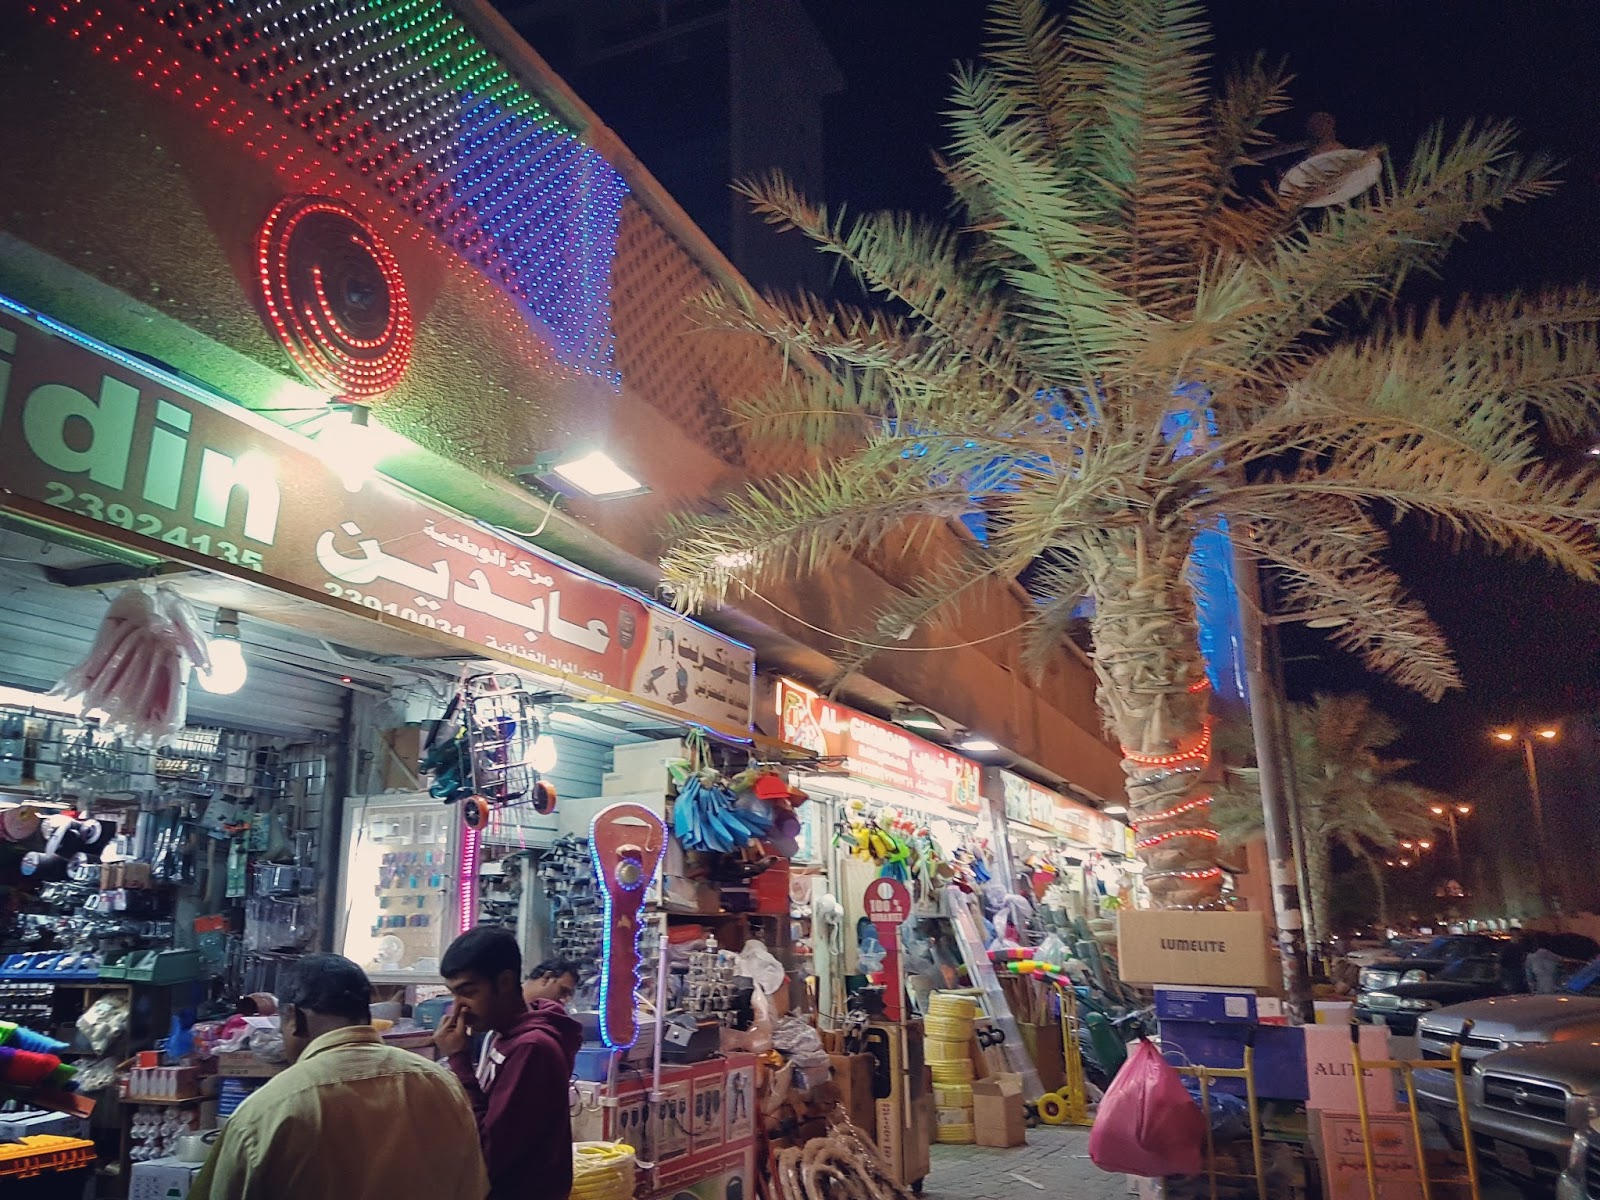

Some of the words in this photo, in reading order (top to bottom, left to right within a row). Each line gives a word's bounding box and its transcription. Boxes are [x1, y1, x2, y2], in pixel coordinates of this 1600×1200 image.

[44, 481, 263, 573] 23924135
[422, 518, 507, 568] الوطنية
[315, 520, 611, 654] عابدين
[507, 560, 555, 588] مركز
[1160, 938, 1226, 953] LUMELITE
